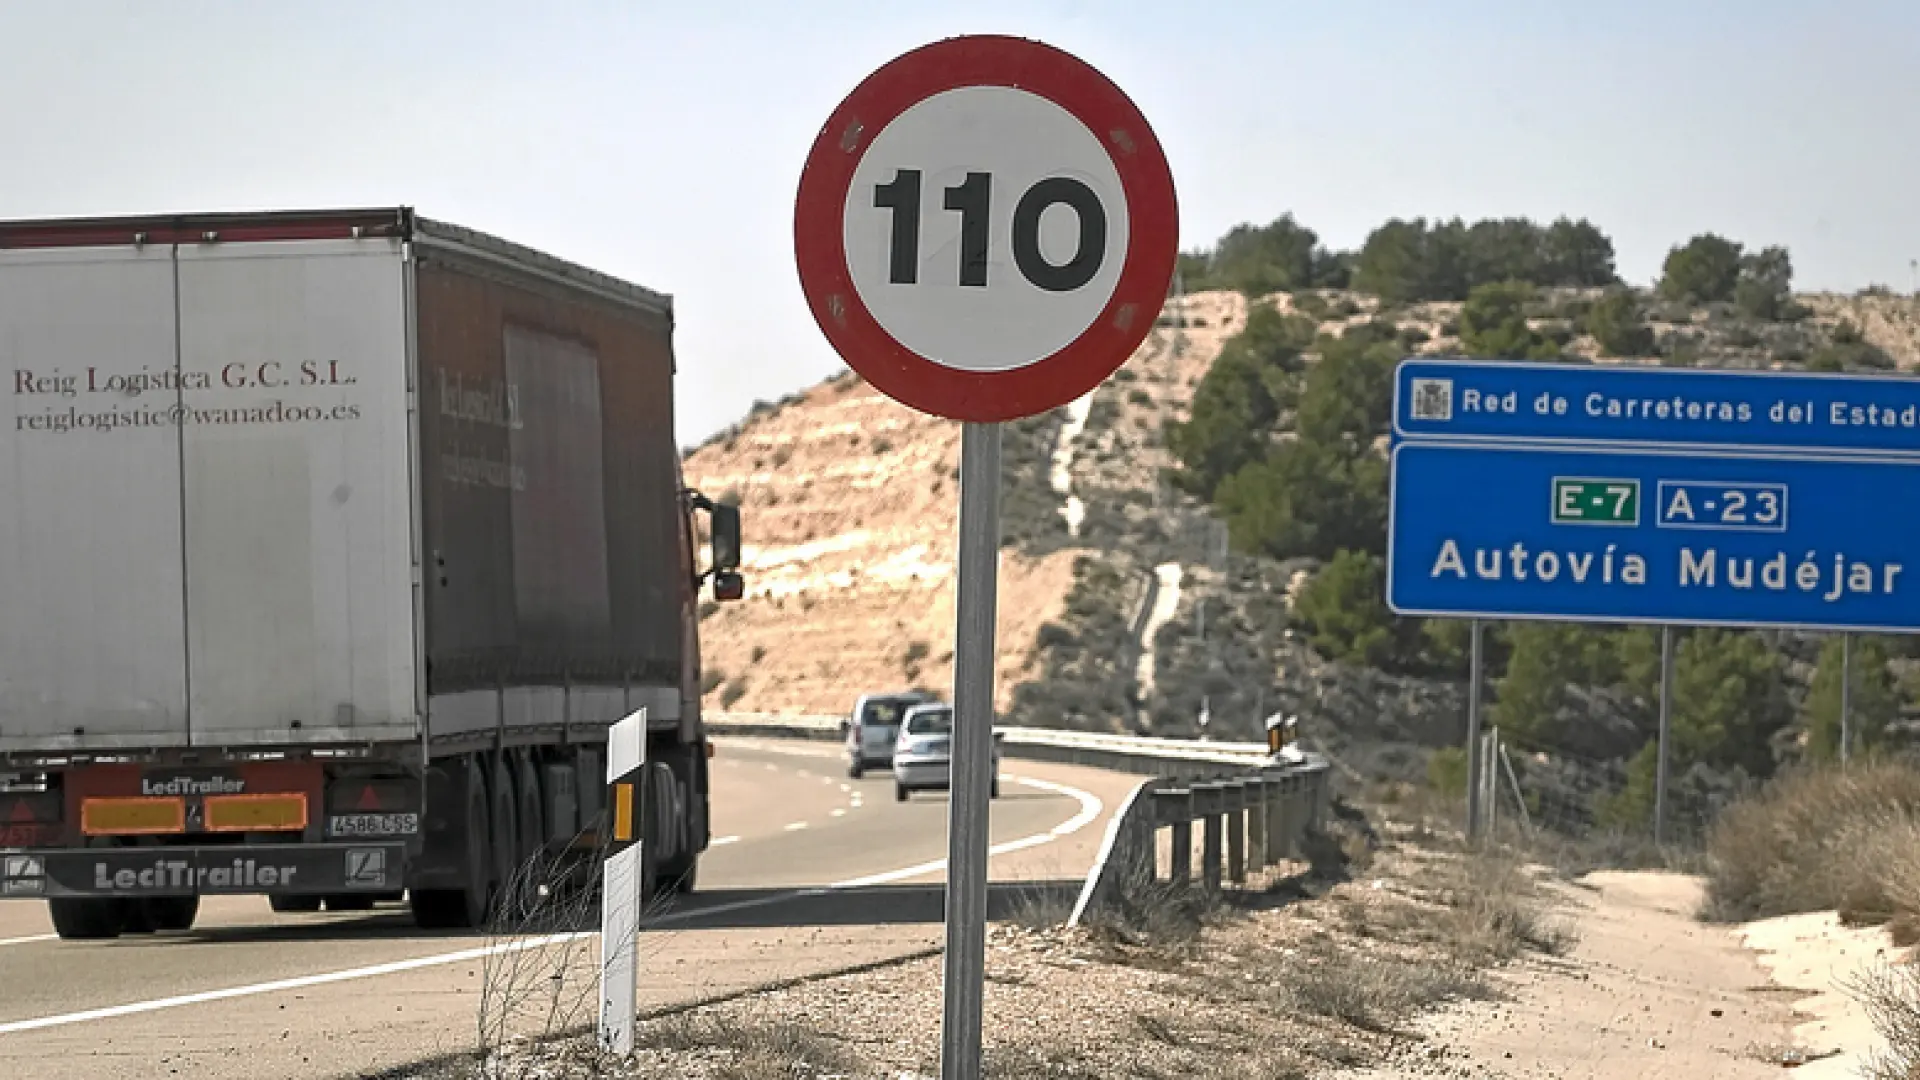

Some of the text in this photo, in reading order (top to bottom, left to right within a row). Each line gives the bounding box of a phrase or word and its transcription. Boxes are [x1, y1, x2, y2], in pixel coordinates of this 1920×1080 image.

[872, 168, 1107, 292] 110
[13, 359, 357, 396] Reig Logistica G.C. S.L.
[15, 400, 362, 433] reiglogistic@wanadoo.es
[1462, 388, 1920, 428] Red de Carreteras del Estad
[1557, 484, 1633, 518] E-7
[1665, 487, 1780, 523] A-23
[1430, 539, 1904, 602] Autovía Mudéjar
[142, 775, 245, 796] LeciTrailer
[94, 857, 297, 889] LeciTrailer
